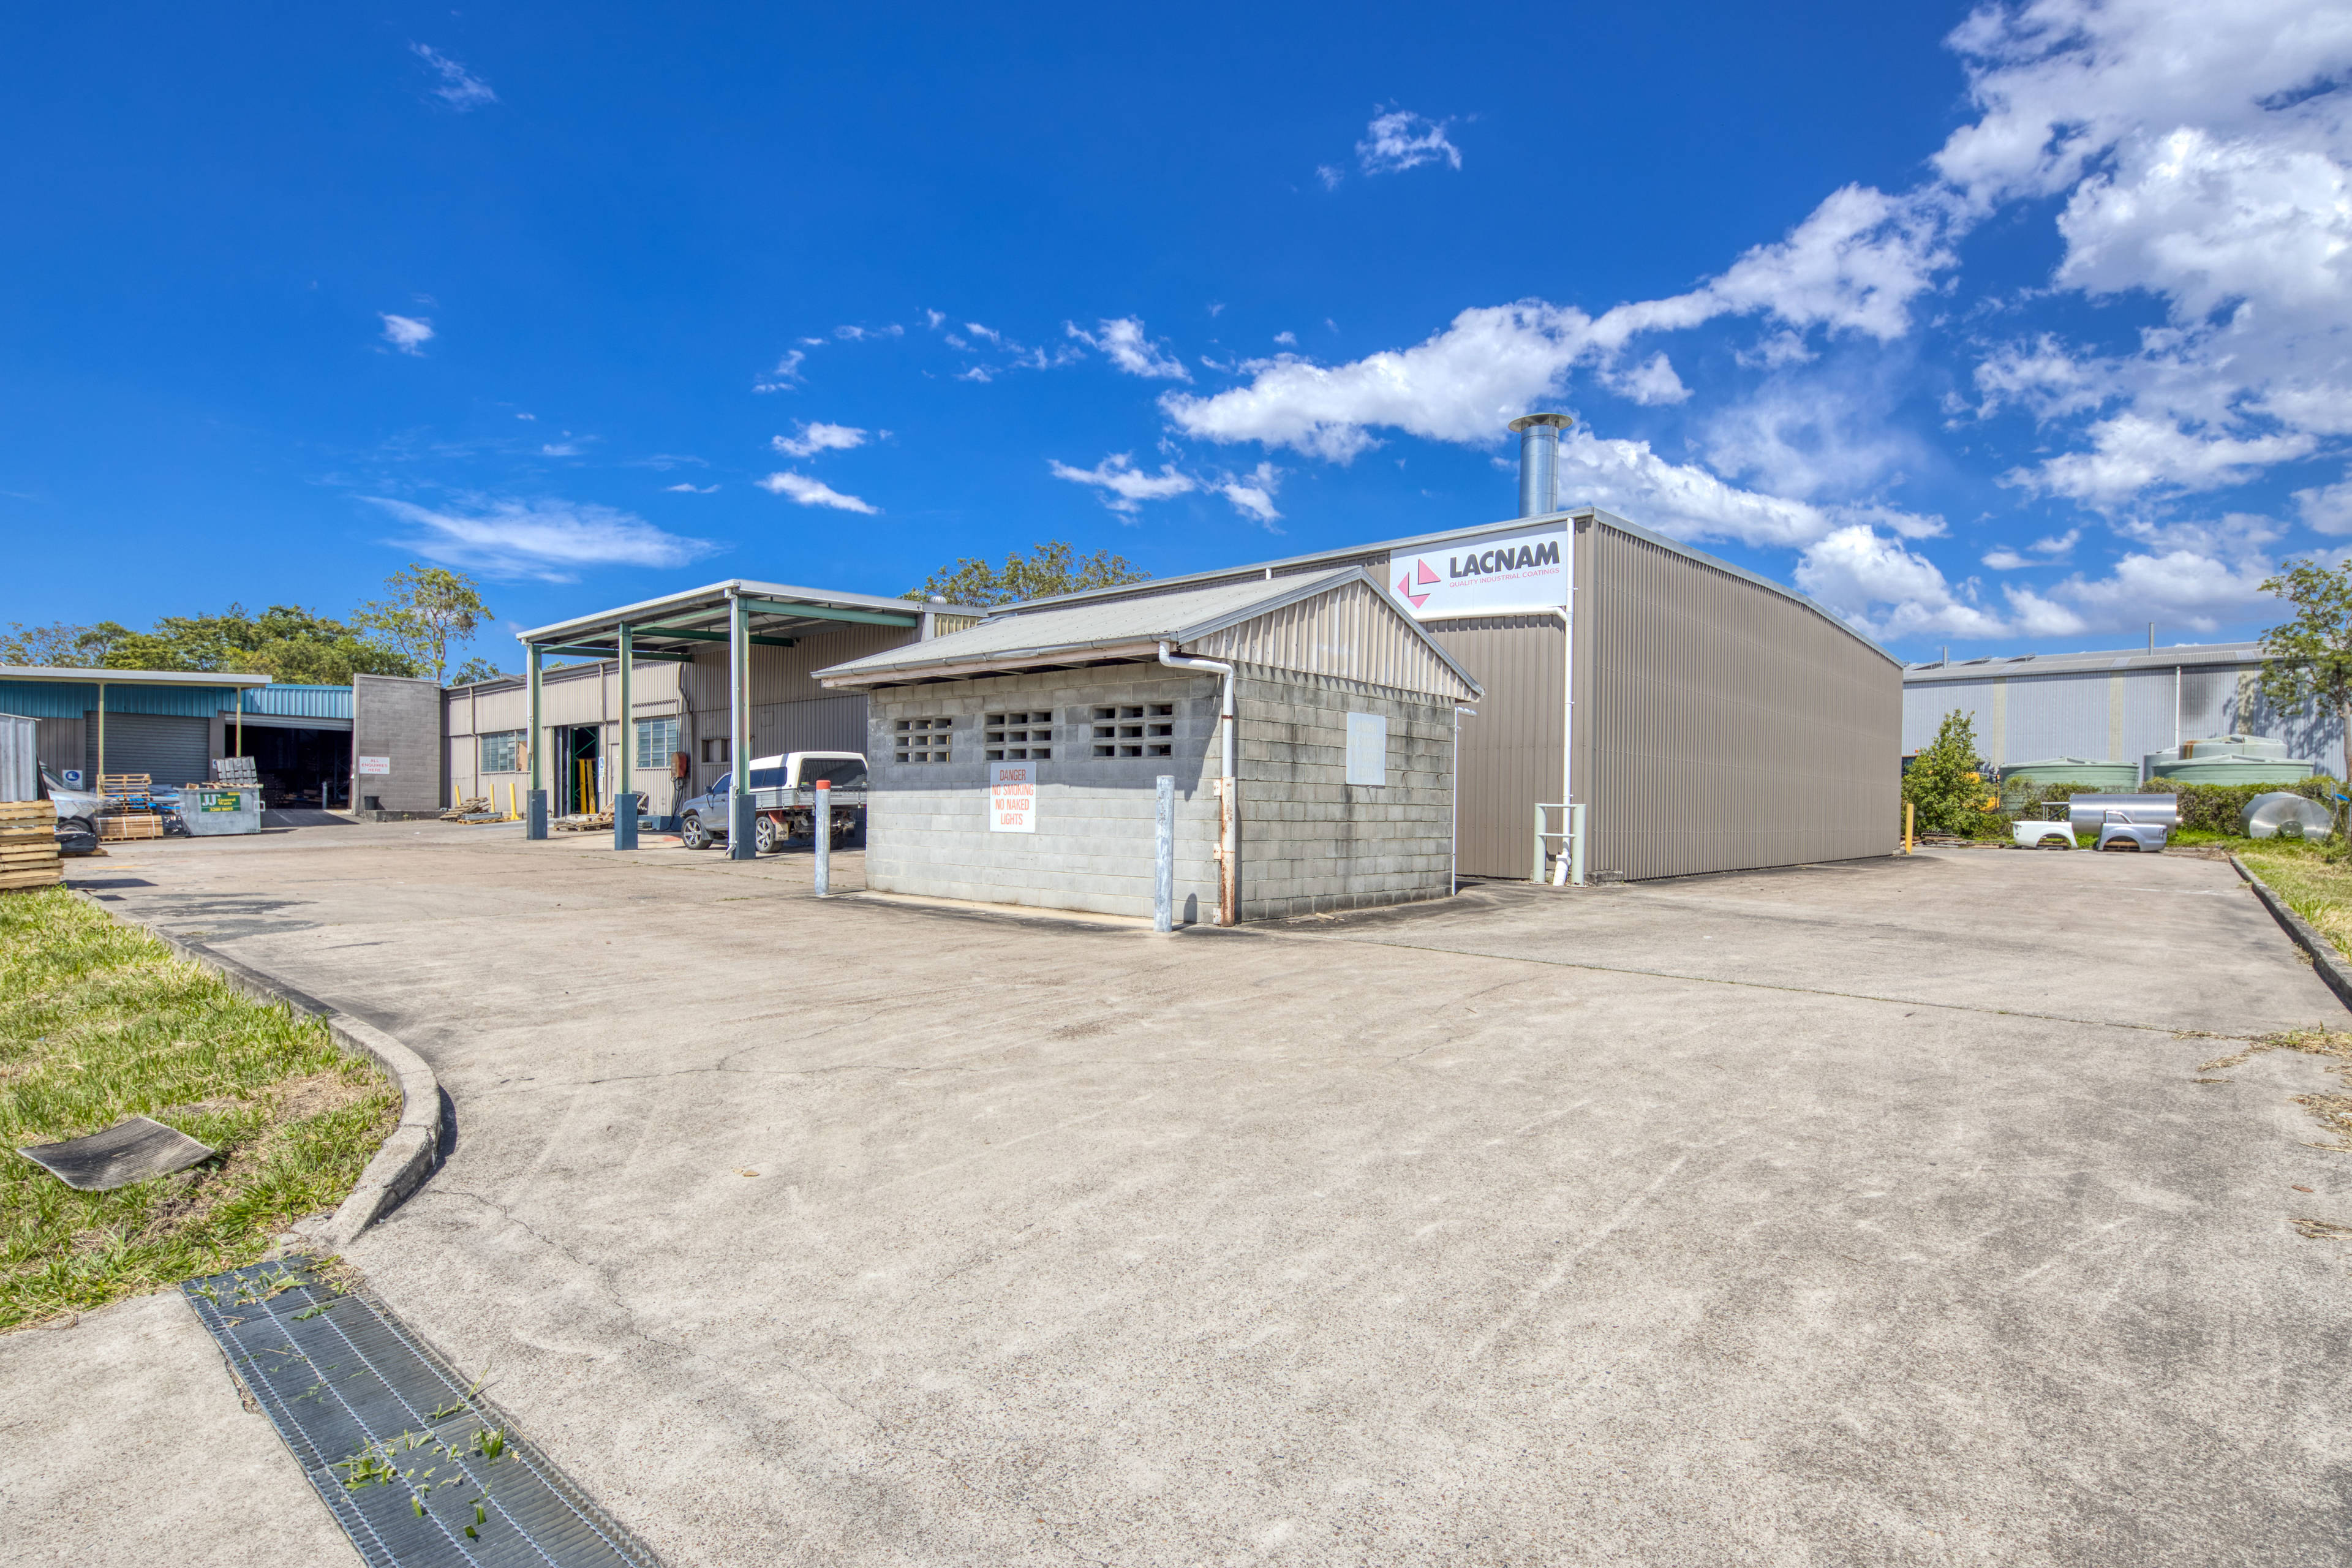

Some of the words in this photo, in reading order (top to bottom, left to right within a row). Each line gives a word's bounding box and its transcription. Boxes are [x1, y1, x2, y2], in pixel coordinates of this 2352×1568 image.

[1450, 541, 1560, 579] LACNAM
[1449, 578, 1479, 587] QUALITY
[1479, 573, 1521, 584] INDUSTRIAL
[1522, 567, 1561, 578] COATINGS
[1000, 769, 1026, 781] DANGER
[992, 784, 1001, 796] NO
[1003, 783, 1034, 796] SMOKING
[995, 799, 1005, 810] NO
[1006, 799, 1030, 810] NAKED
[1001, 813, 1023, 825] LIGHTS
